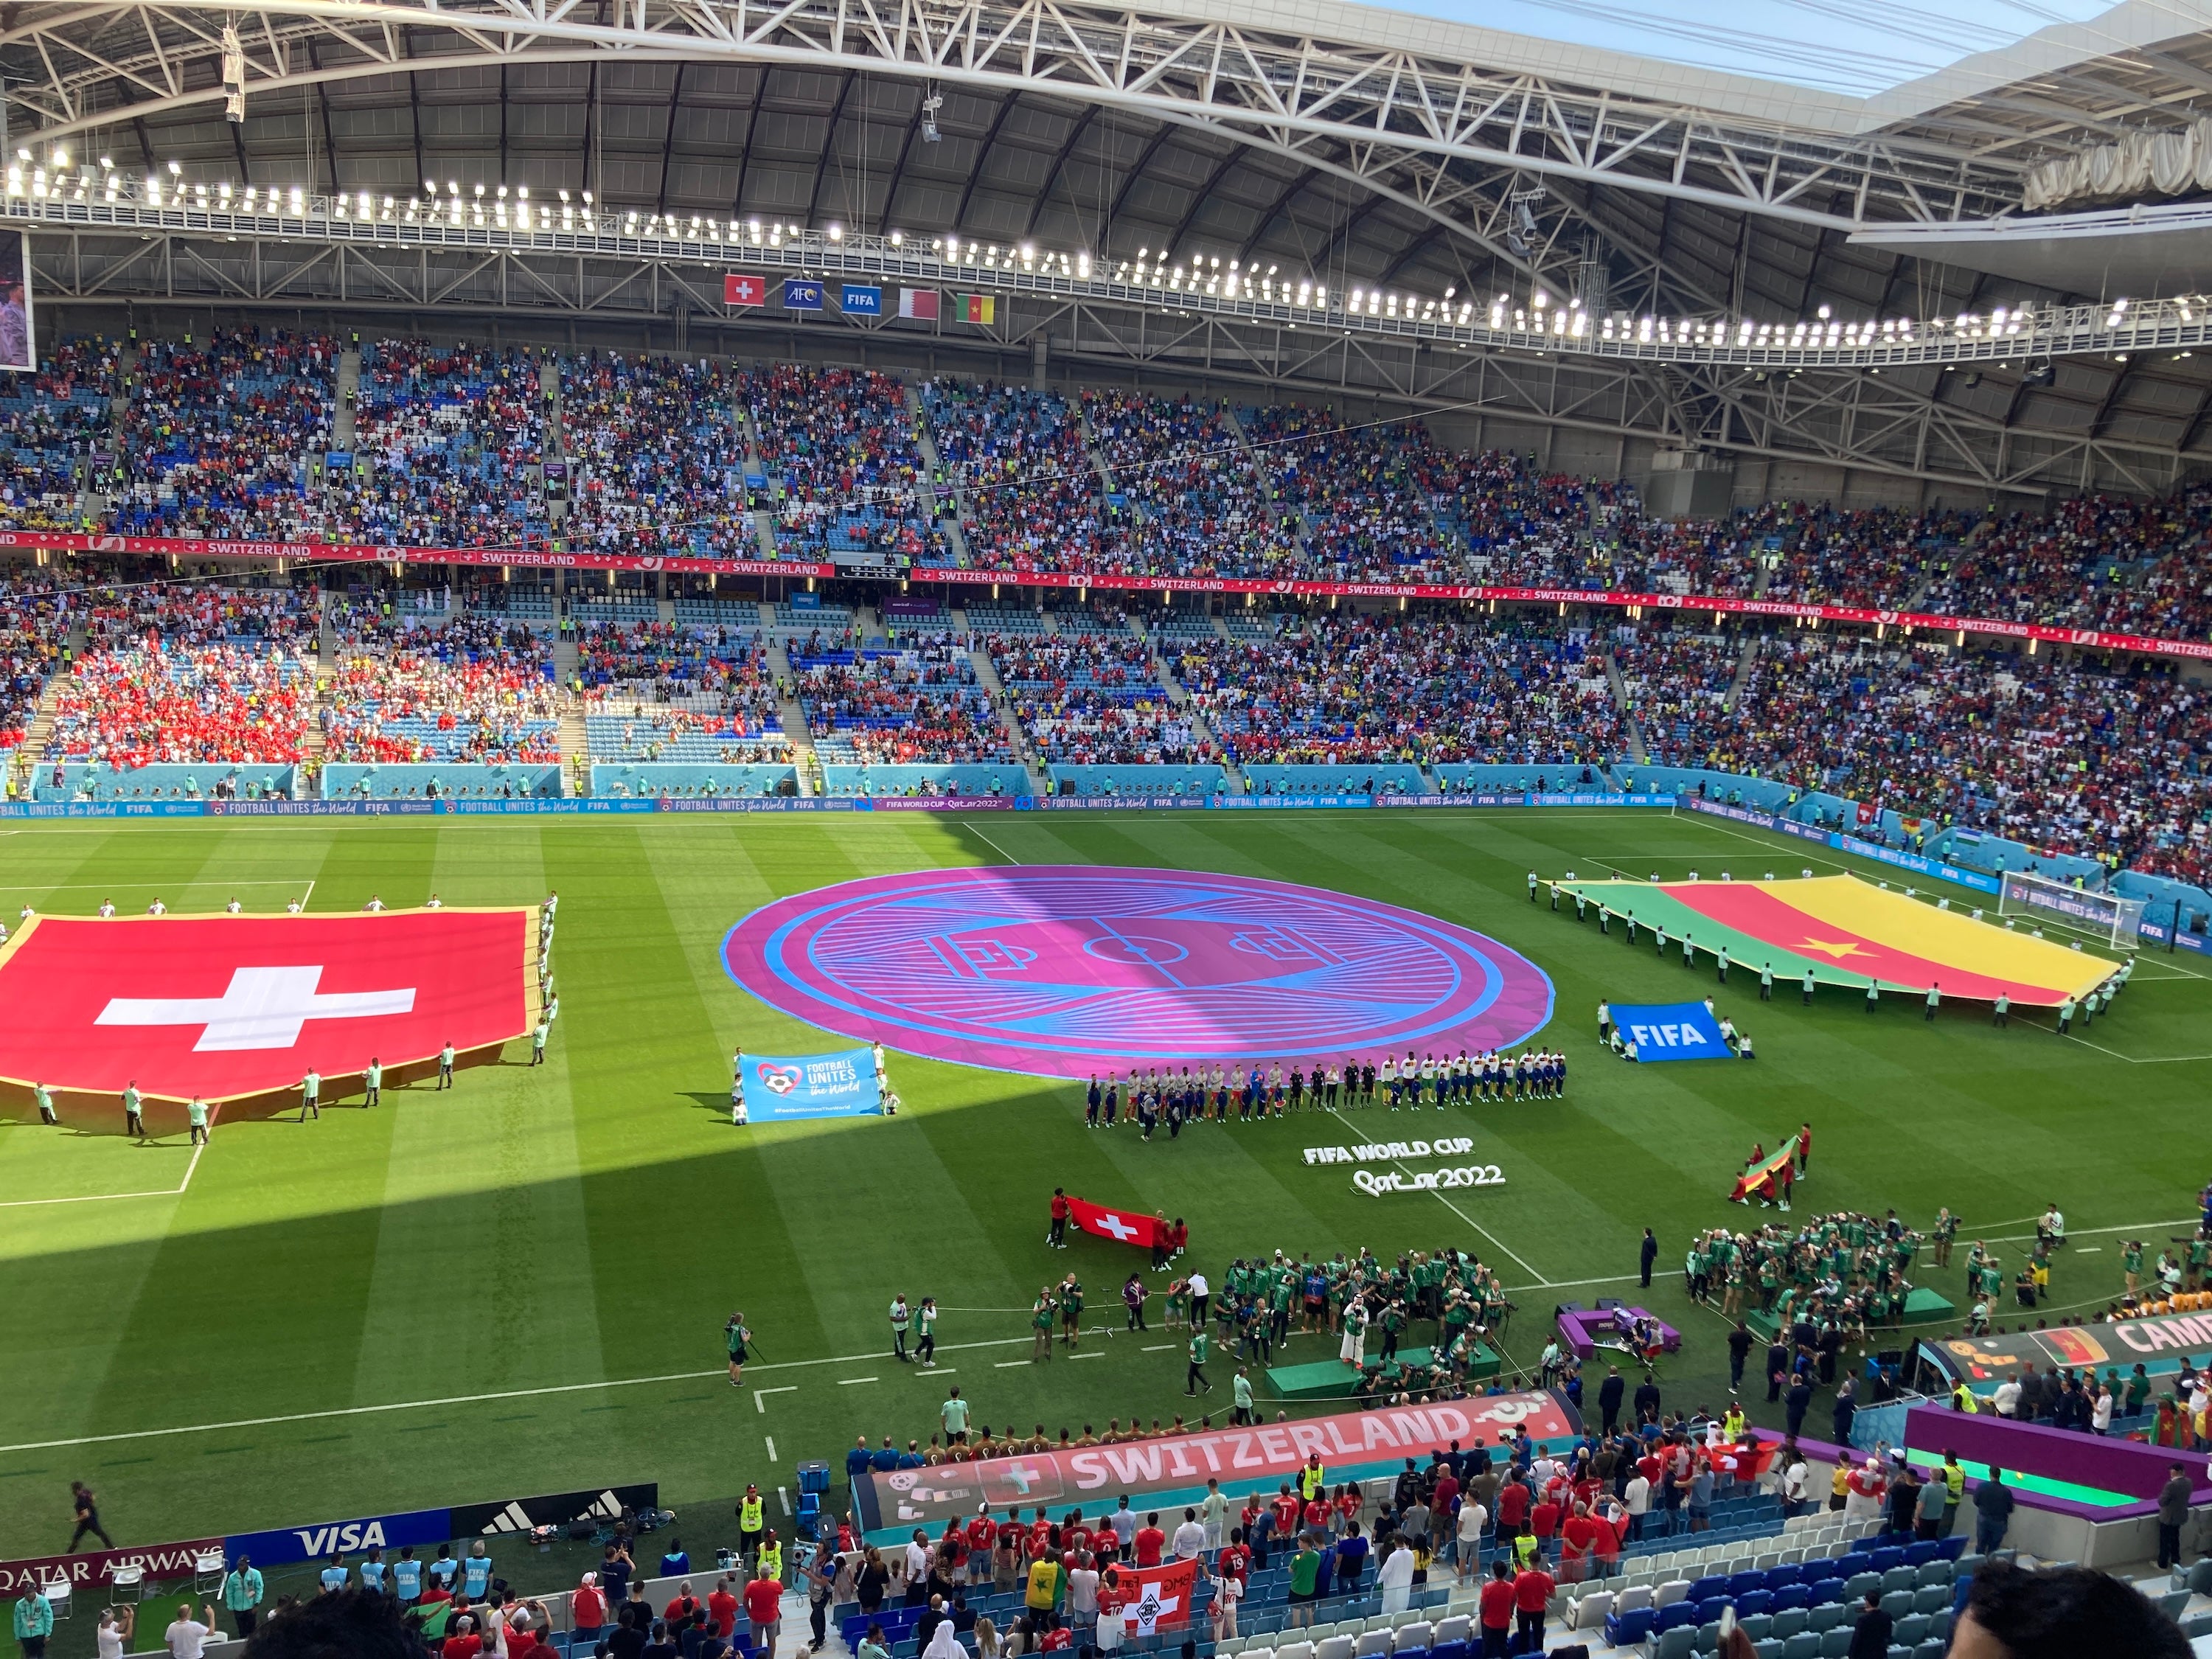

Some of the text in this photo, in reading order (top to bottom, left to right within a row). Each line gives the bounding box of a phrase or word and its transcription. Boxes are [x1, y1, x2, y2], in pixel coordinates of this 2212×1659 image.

[788, 287, 817, 301] AFC
[847, 294, 874, 307] FIFA
[209, 543, 311, 556] SWITZERLAND
[482, 552, 574, 565] SWITZERLAND
[733, 563, 818, 574] SWITZERLAND
[939, 571, 1018, 582] SWITZERLAND
[1151, 579, 1224, 589] SWITZERLAND
[1348, 585, 1416, 595] SWITZERLAND
[1534, 590, 1607, 602] SWITZERLAND
[1743, 601, 1823, 616] SWITZERLAND
[1956, 619, 2028, 635] SWITZERLAND
[676, 800, 786, 811] FOOTBALL UNITES the World
[1053, 798, 1147, 808] FOOTBALL UNITES the World
[1225, 796, 1314, 808] FOOTBALL UNITES the World
[1388, 795, 1473, 805] FOOTBALL UNITES the World
[1543, 796, 1571, 804] FOOTBALL
[1595, 796, 1606, 804] the
[1606, 795, 1624, 804] World
[1, 803, 116, 817] BALL UNITES the World
[127, 804, 153, 813] FIFA
[229, 801, 358, 815] FOOTBALL UNITES the World
[366, 804, 389, 813] FIFA
[461, 801, 579, 813] FOOTBALL UNITES the World
[1700, 801, 1727, 815] FOOTBALL
[1728, 809, 1746, 819] UNITES
[1784, 823, 1800, 834] FIFA
[1851, 841, 1877, 856] FOOTBALL
[1879, 849, 1899, 860] UNITES
[1941, 868, 1958, 879] FIFA
[2059, 898, 2084, 913] UNITES
[2140, 923, 2163, 937] FIFA
[1630, 1023, 1707, 1048] FIFA
[807, 1060, 853, 1074] FOOTBALL
[808, 1068, 857, 1084] UNITES
[810, 1079, 860, 1095] the World
[774, 1104, 850, 1113] #FootballUnitesTheWorld
[1304, 1138, 1474, 1166] FIFA WORLD CUP
[1352, 1165, 1506, 1197] Qatar2022
[1071, 1408, 1471, 1489] SWITZERLAND
[293, 1522, 386, 1557] VISA
[978, 1528, 987, 1540] 4
[1233, 1558, 1244, 1571] 19
[1107, 1606, 1122, 1618] 10
